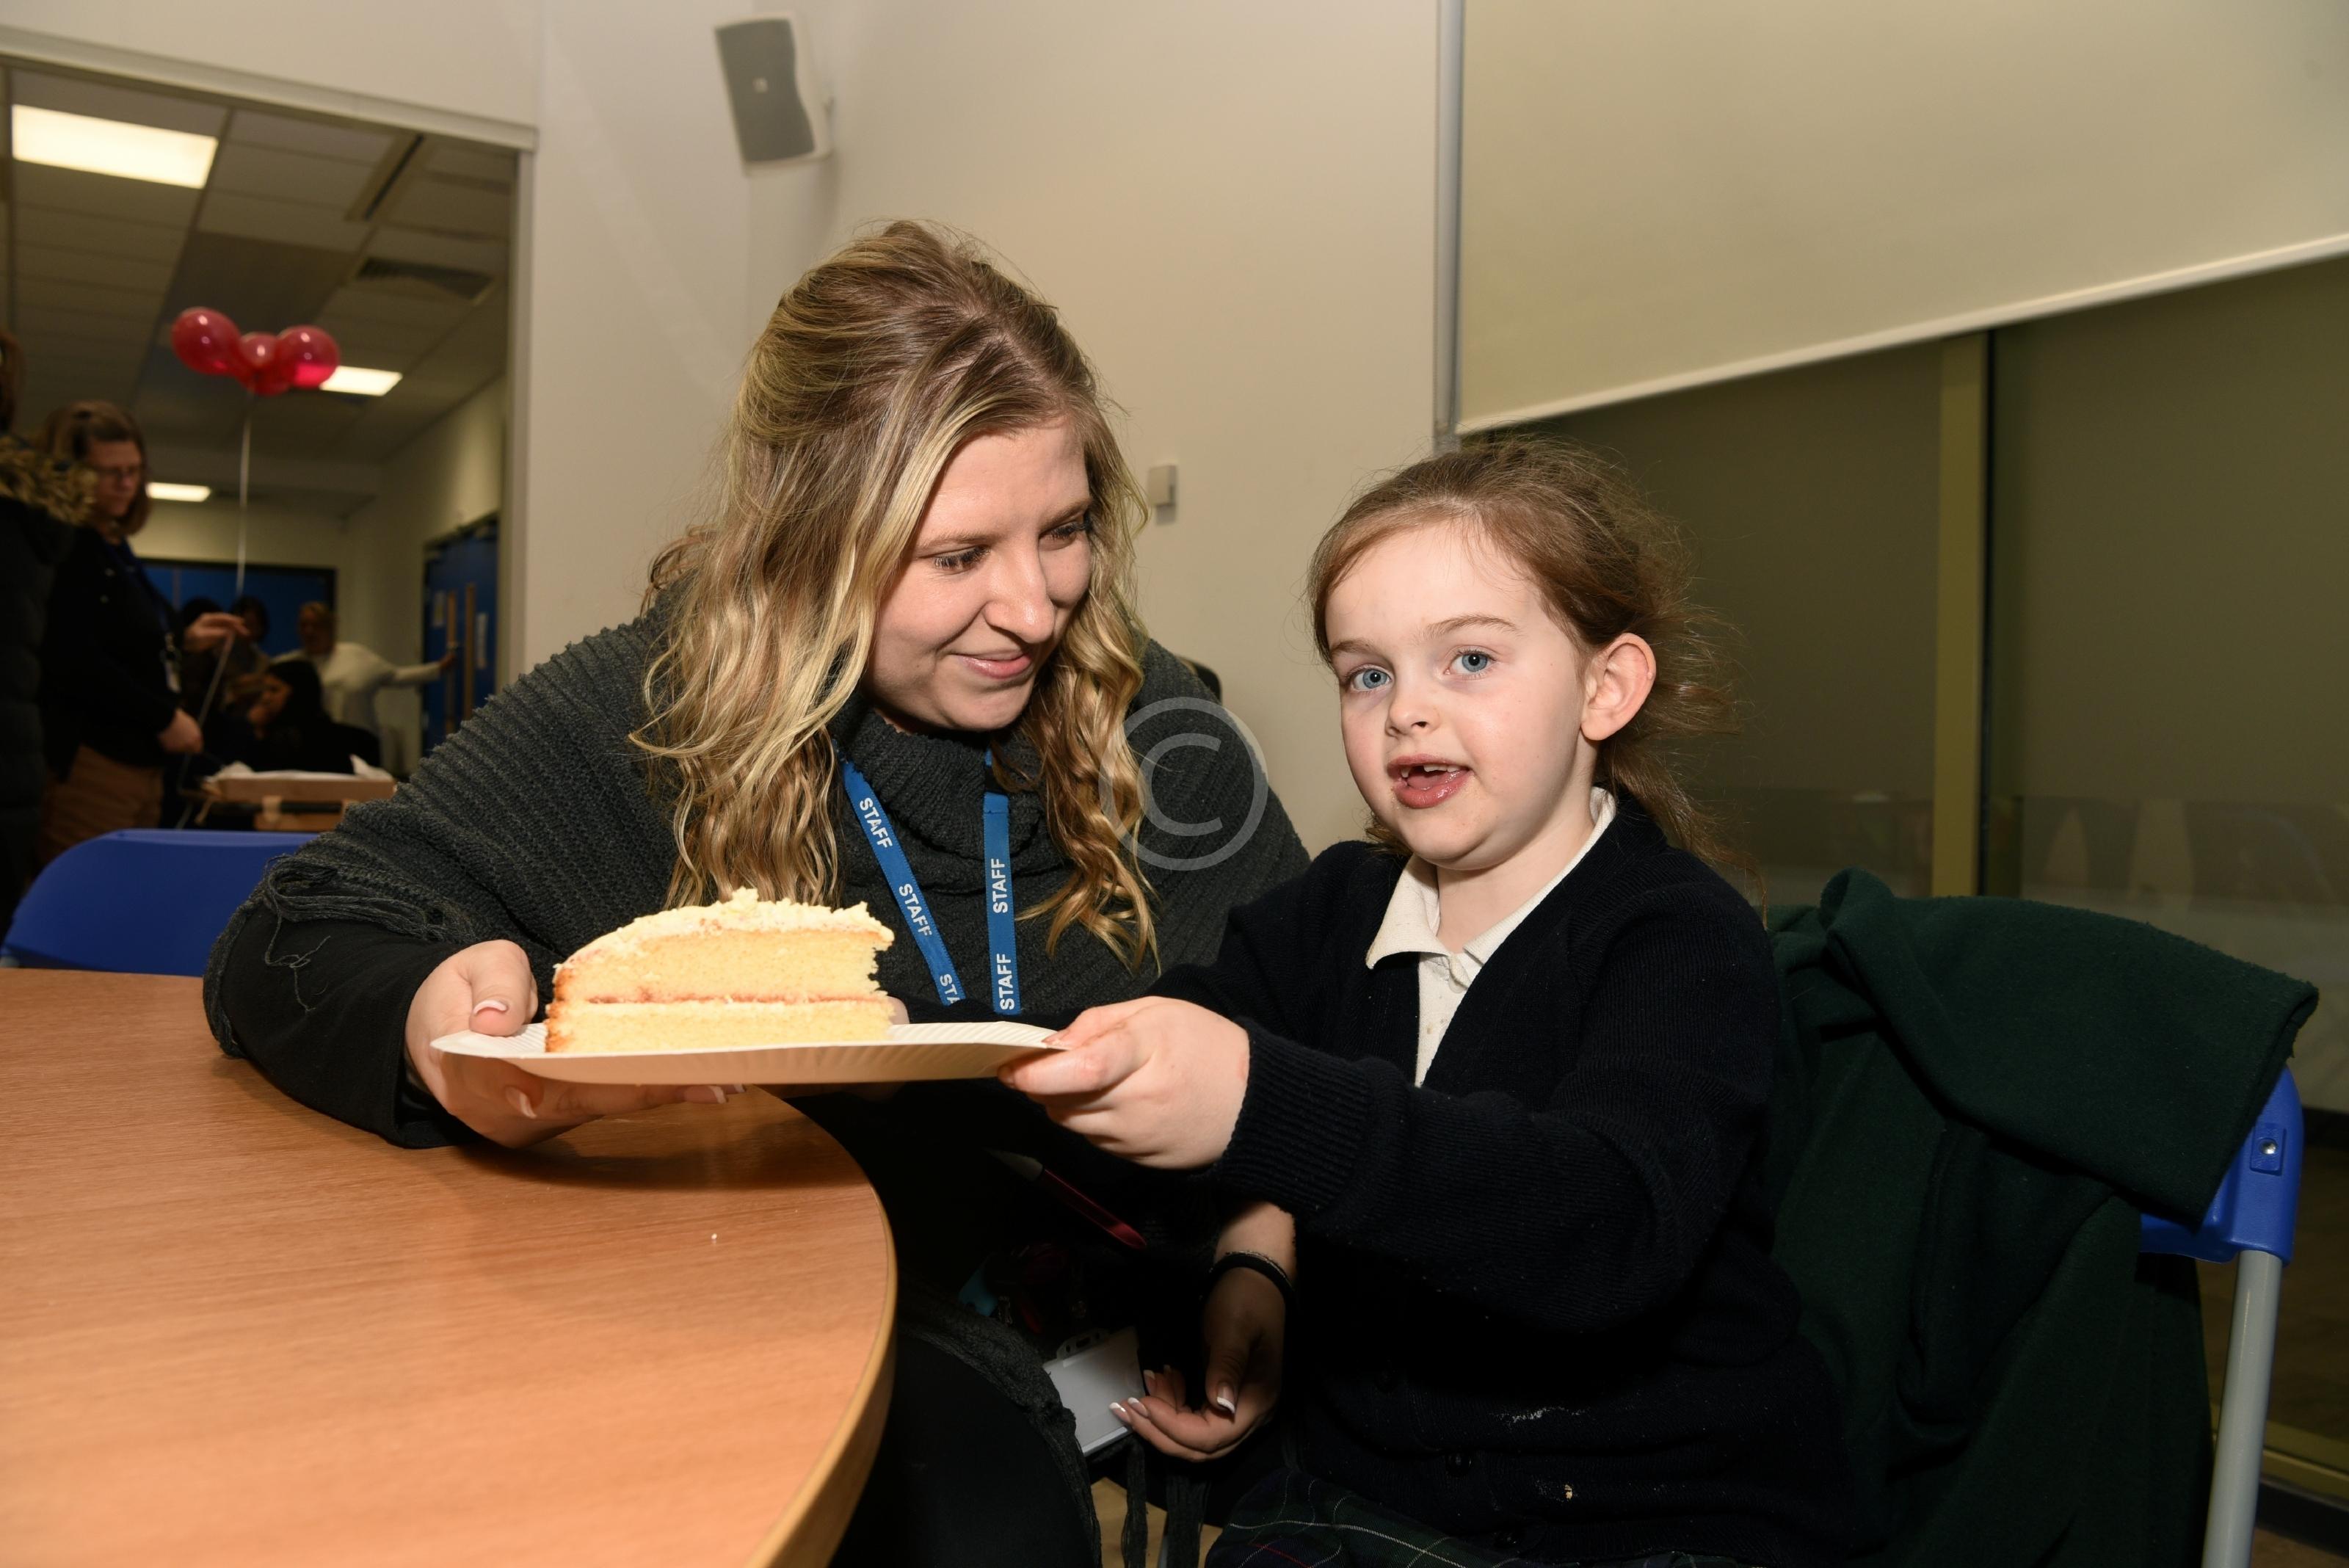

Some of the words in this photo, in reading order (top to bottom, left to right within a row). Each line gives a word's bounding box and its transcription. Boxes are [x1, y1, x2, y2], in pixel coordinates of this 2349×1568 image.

[859, 797, 893, 848] STAFF
[898, 883, 932, 936] STAFF
[990, 858, 1009, 913] STAFF
[996, 953, 1015, 1010] STAFF
